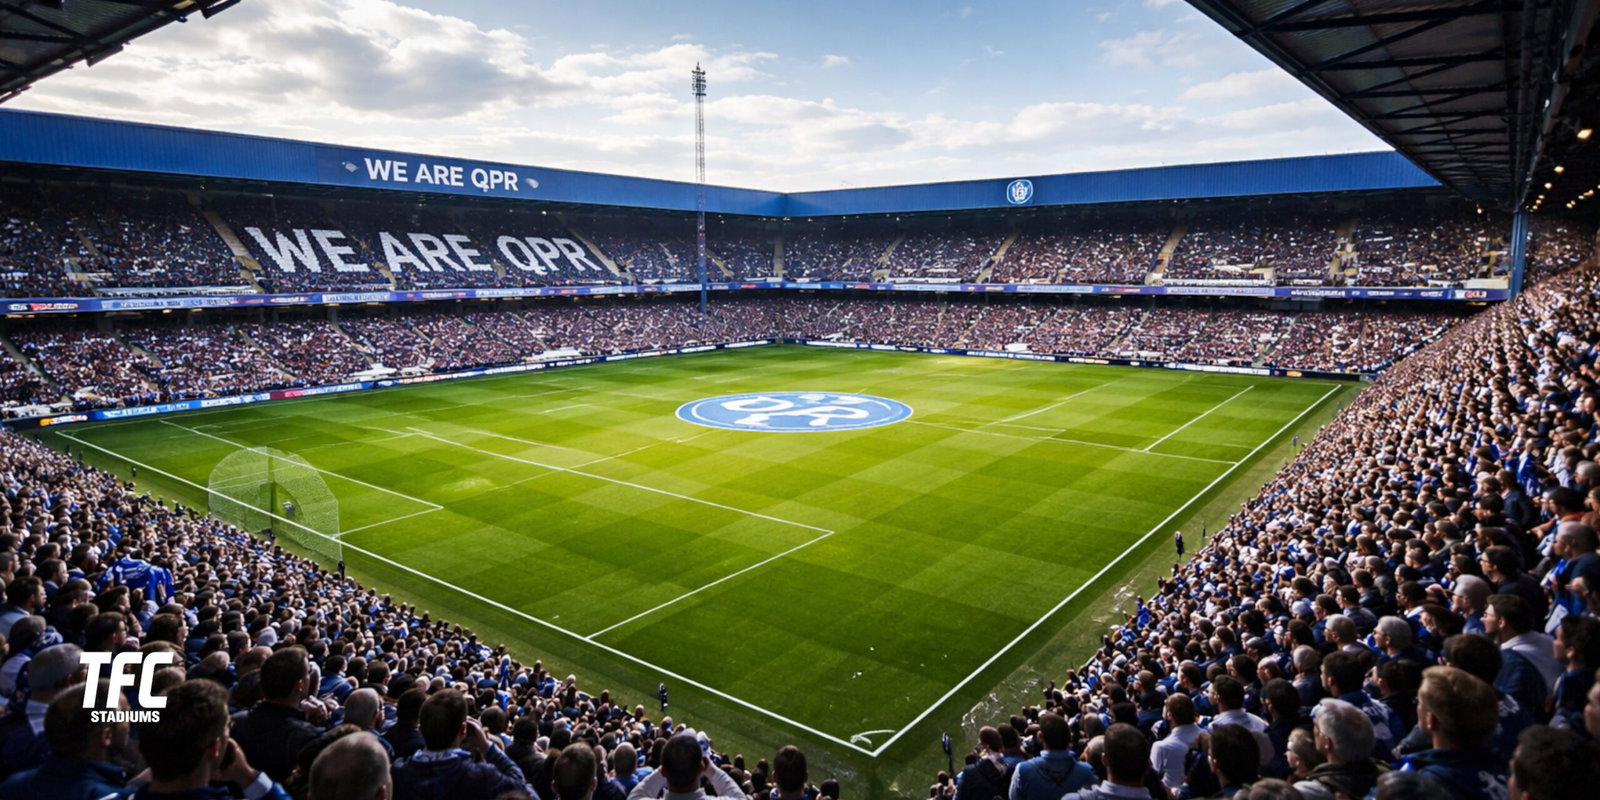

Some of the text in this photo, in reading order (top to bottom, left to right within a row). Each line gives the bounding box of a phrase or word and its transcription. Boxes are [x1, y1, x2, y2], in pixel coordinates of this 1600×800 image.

[364, 158, 518, 192] WE ARE QPR
[244, 227, 602, 275] WE ARE QPR
